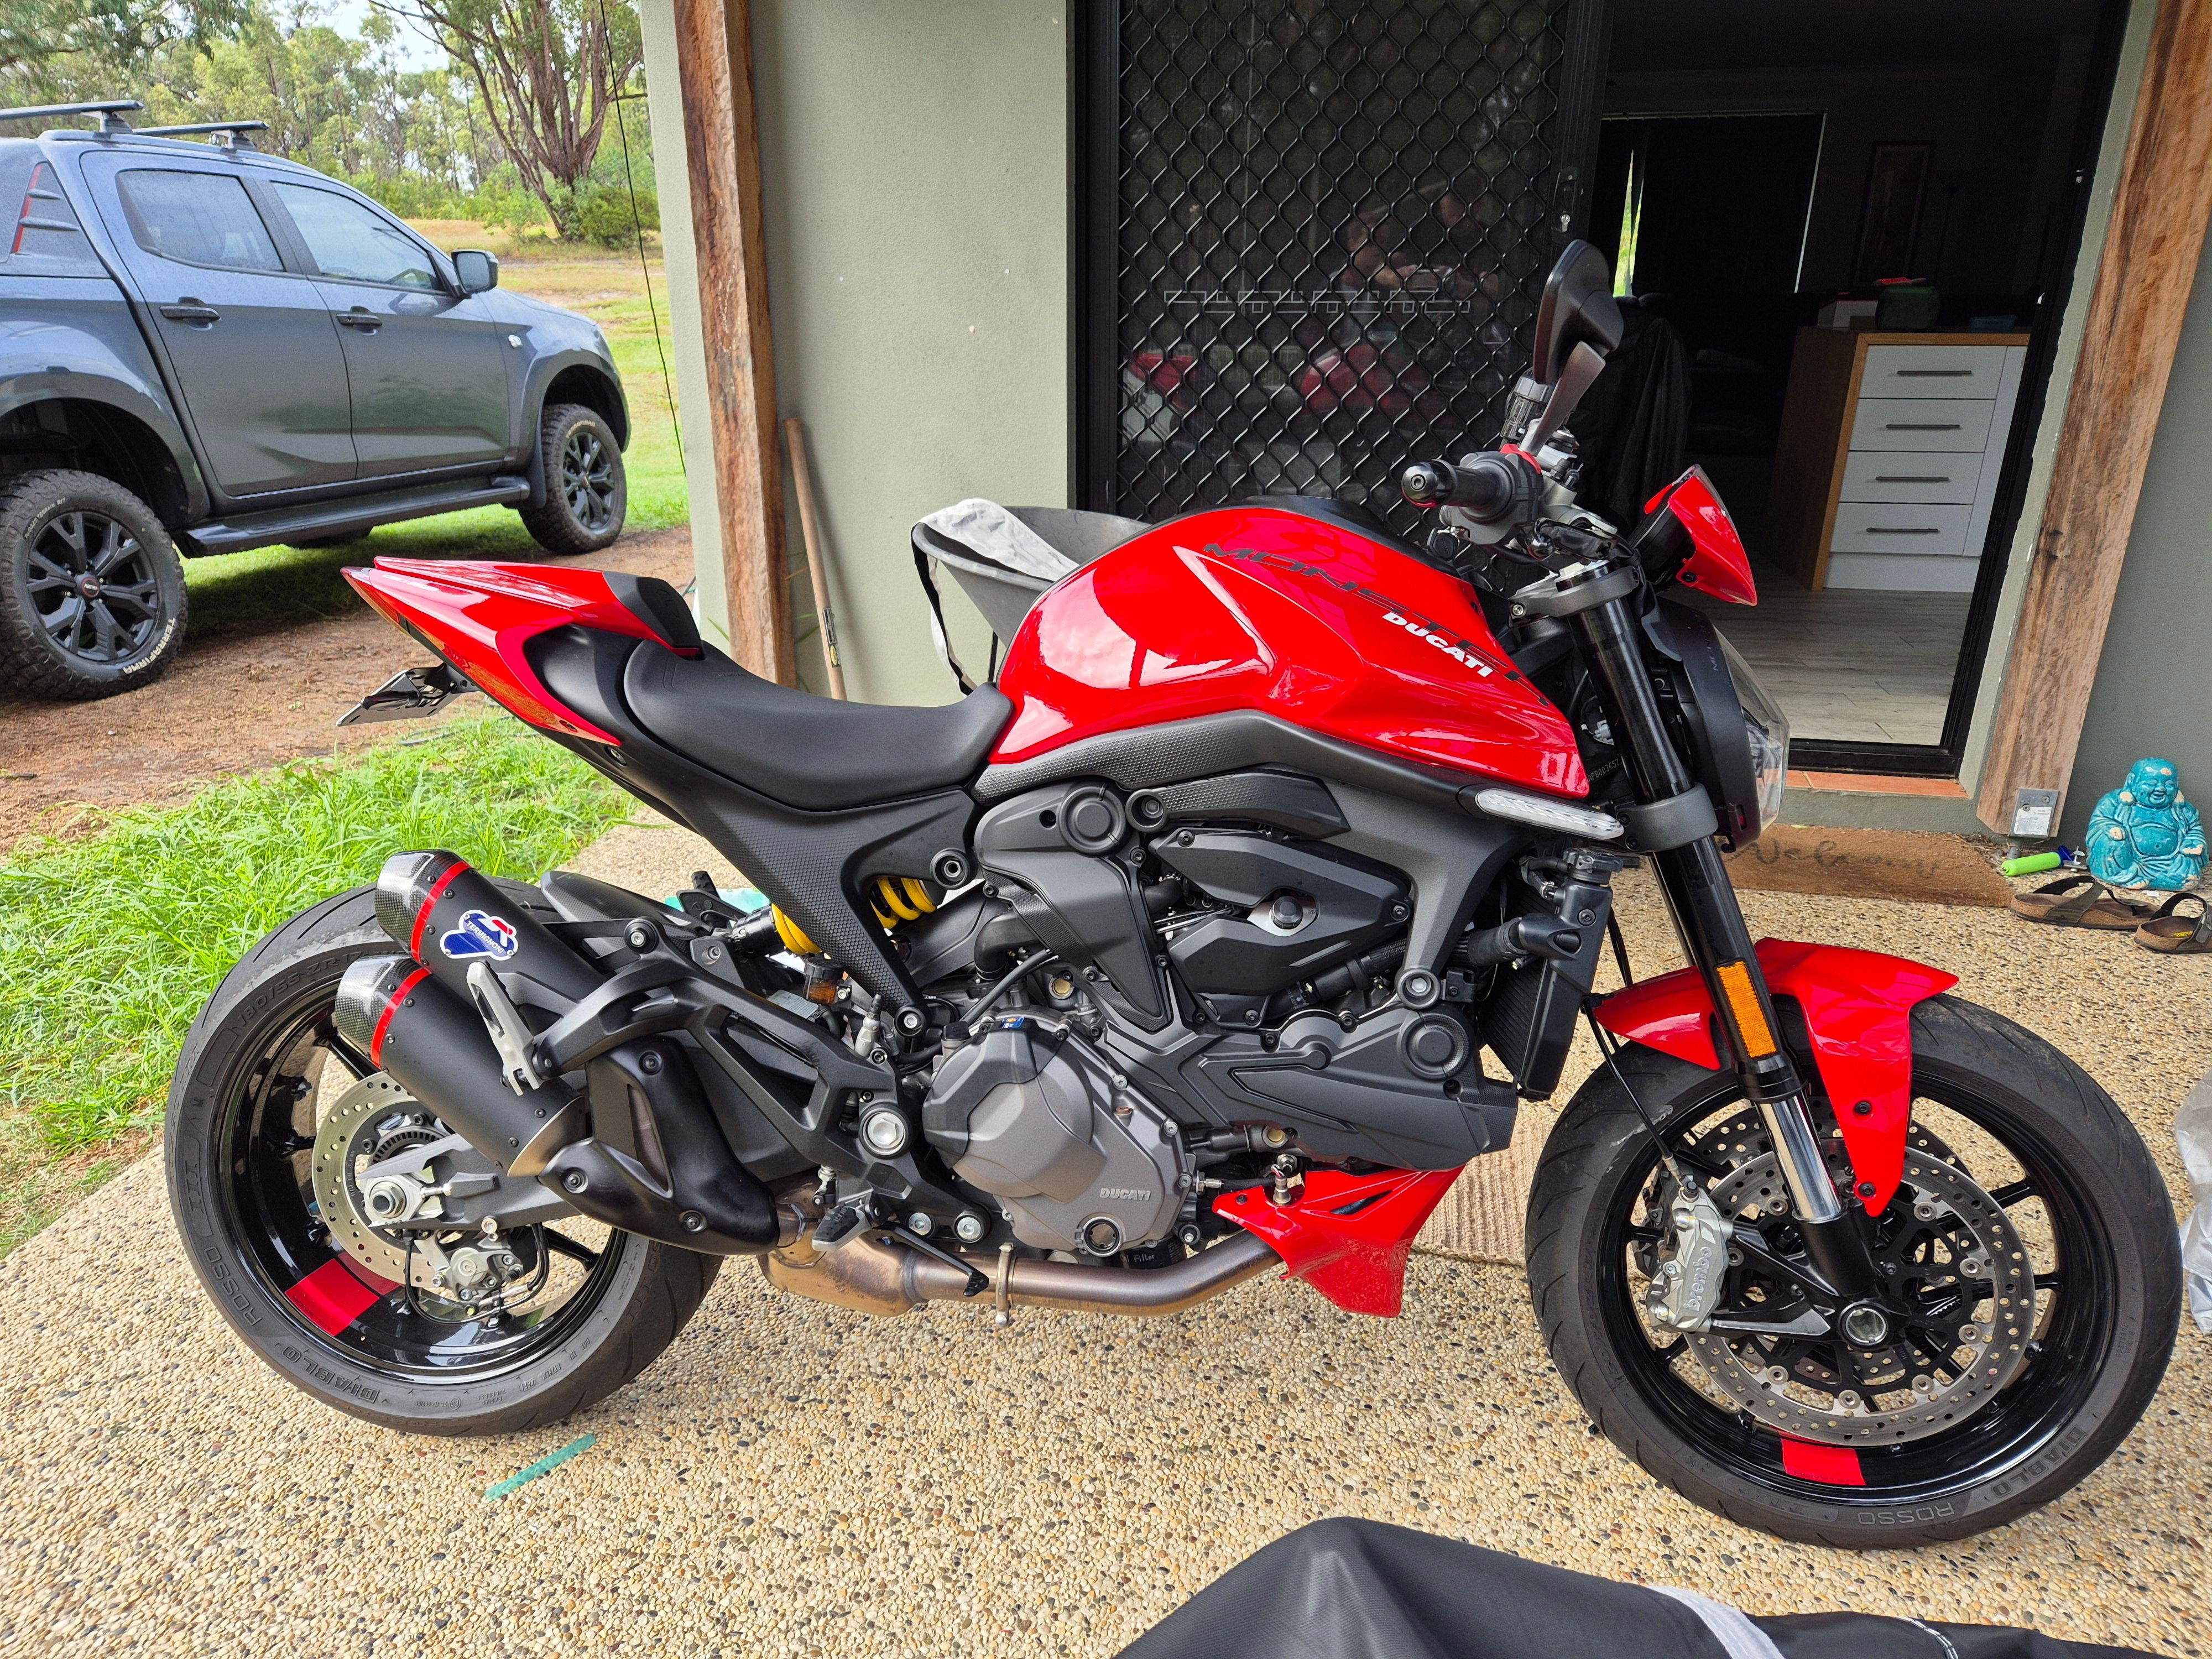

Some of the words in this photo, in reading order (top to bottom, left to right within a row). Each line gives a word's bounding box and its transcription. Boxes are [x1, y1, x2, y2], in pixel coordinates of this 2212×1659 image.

[123, 617, 176, 674] TERRAFIRMA
[1383, 612, 1493, 677] DUCATI
[466, 920, 505, 954] TERMIGNONI
[1099, 1187, 1151, 1201] DUCATI
[204, 1246, 263, 1327] ROSSO
[1683, 1246, 1713, 1312] brembo
[282, 1345, 382, 1404] DIABLO
[1991, 1426, 2088, 1499] DIABLO
[1857, 1502, 1955, 1526] ROSSO
